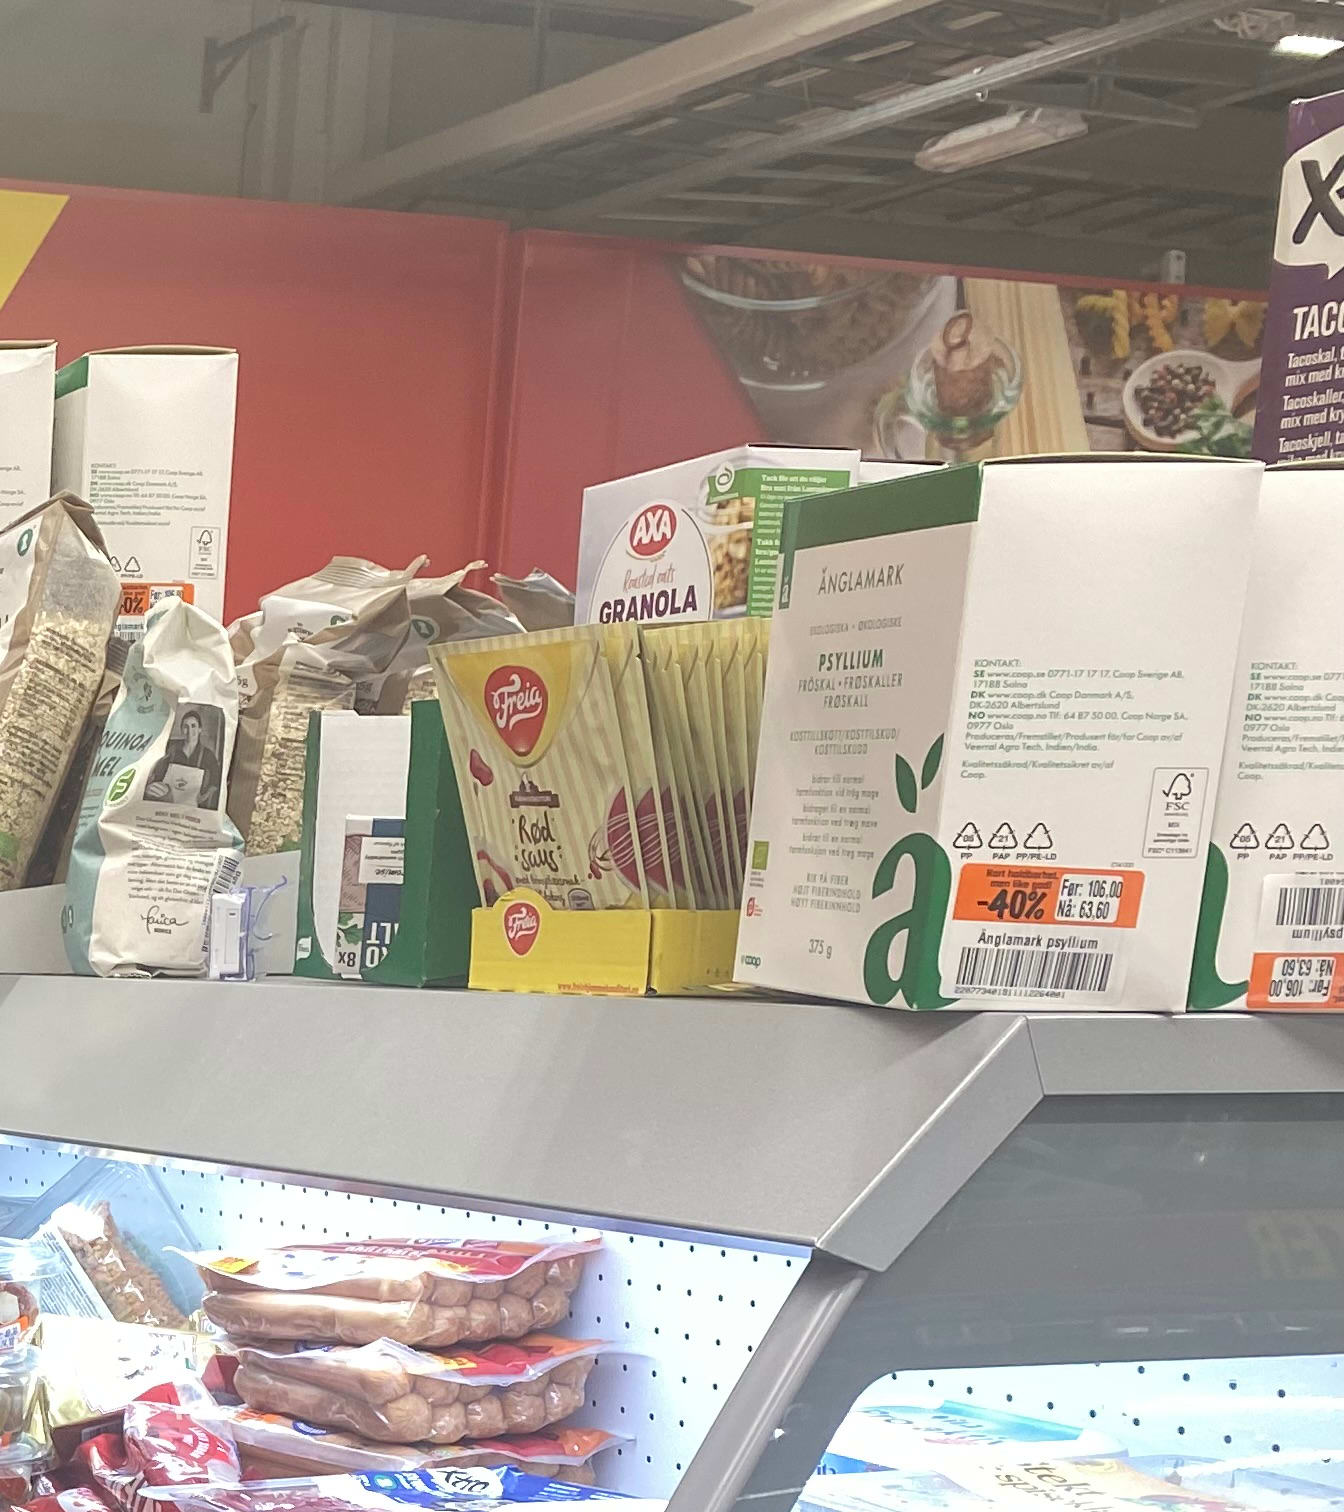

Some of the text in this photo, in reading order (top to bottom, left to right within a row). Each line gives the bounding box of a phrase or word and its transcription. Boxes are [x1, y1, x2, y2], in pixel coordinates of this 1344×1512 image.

[632, 506, 674, 548] AXA
[598, 585, 698, 624] GRANOLA
[818, 649, 883, 672] PSYLLIUM
[973, 670, 985, 678] SE
[492, 672, 544, 731] Freia
[970, 691, 985, 699] DK
[968, 711, 985, 720] NO
[1164, 802, 1190, 812] FSC
[519, 811, 555, 845] Rød
[521, 849, 559, 873] saus
[1062, 878, 1123, 899] Før: 106,00
[977, 889, 1048, 921] -40%
[1057, 899, 1110, 921] Nå: 63,60
[508, 906, 538, 940] Freia
[809, 938, 833, 959] 375 g
[978, 929, 1099, 951] Änglamark psyllium
